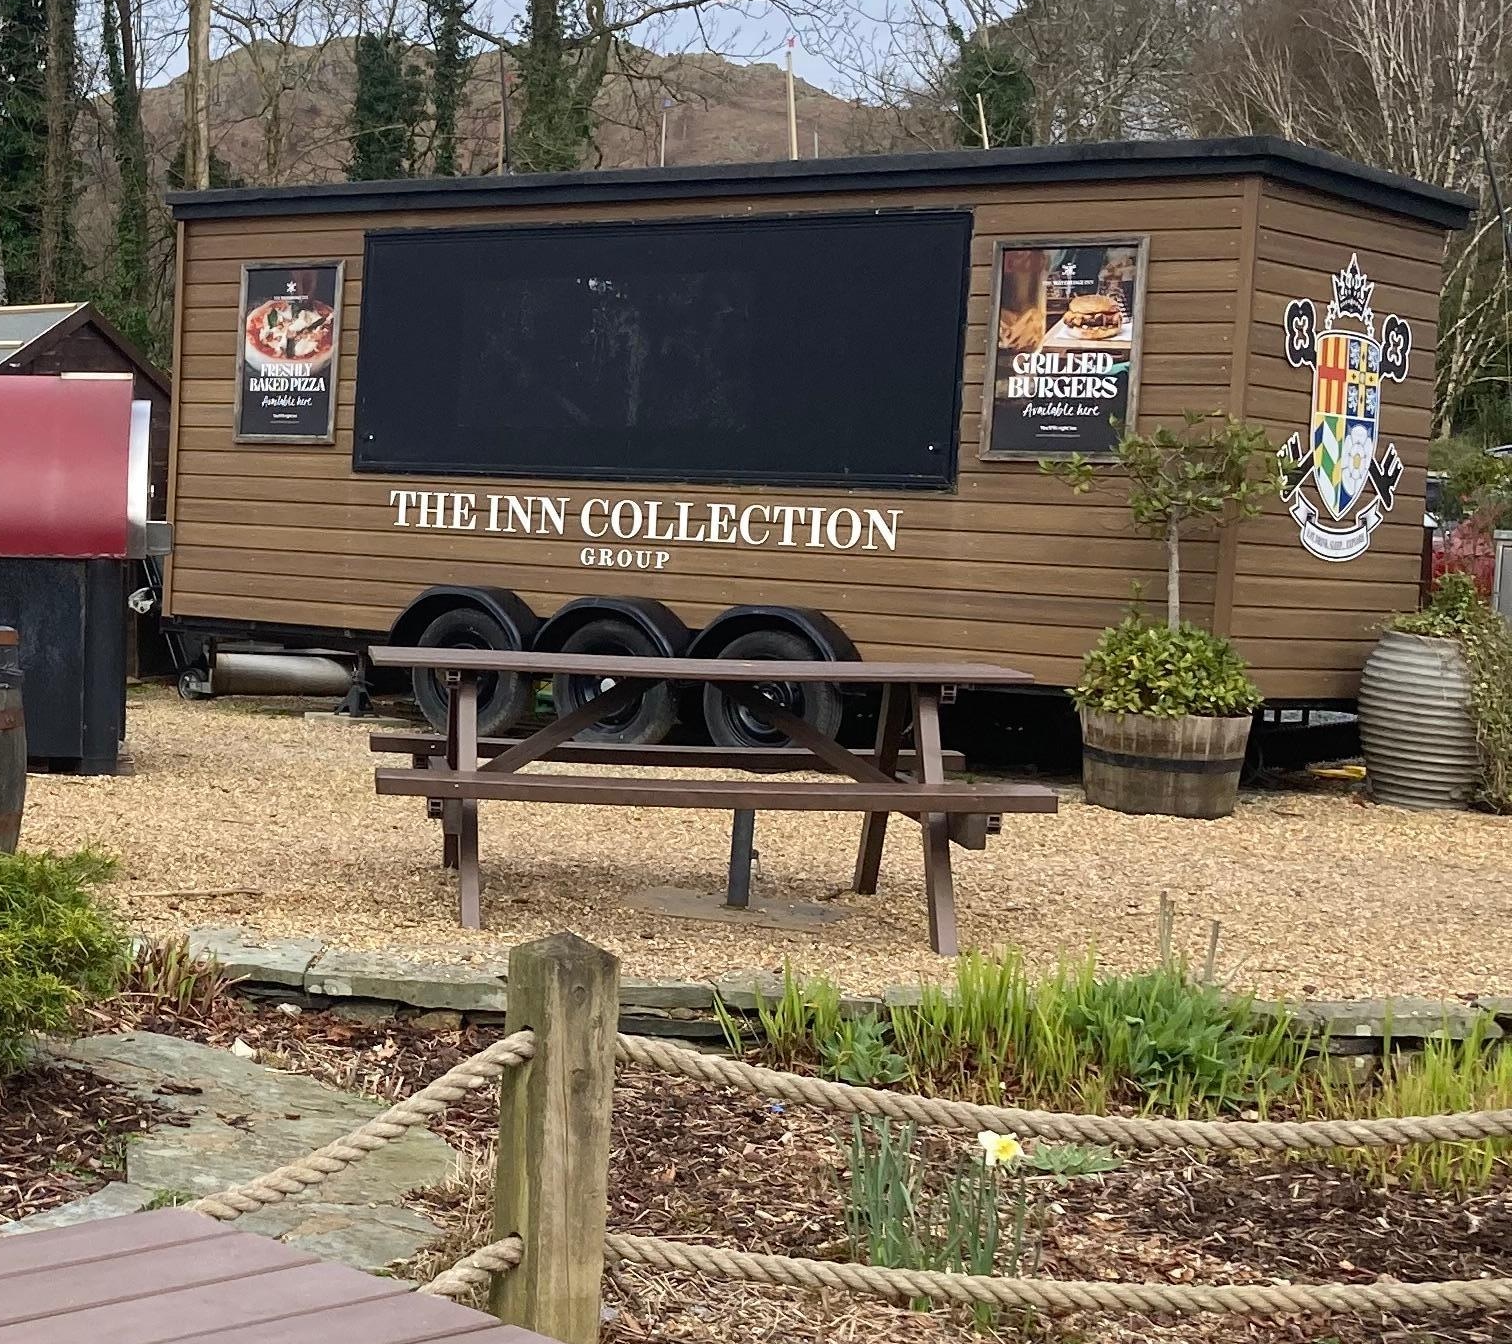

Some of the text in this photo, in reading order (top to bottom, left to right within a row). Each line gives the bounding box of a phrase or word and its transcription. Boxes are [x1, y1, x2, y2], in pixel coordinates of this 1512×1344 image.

[260, 362, 313, 377] FRESHLY
[1012, 352, 1114, 375] GRILLED
[249, 377, 326, 392] BAKED PIZZA
[1007, 376, 1119, 399] BURGERS
[1022, 401, 1101, 418] Available here
[389, 489, 905, 552] THE INN COLLECTION
[579, 547, 672, 571] GROUP
